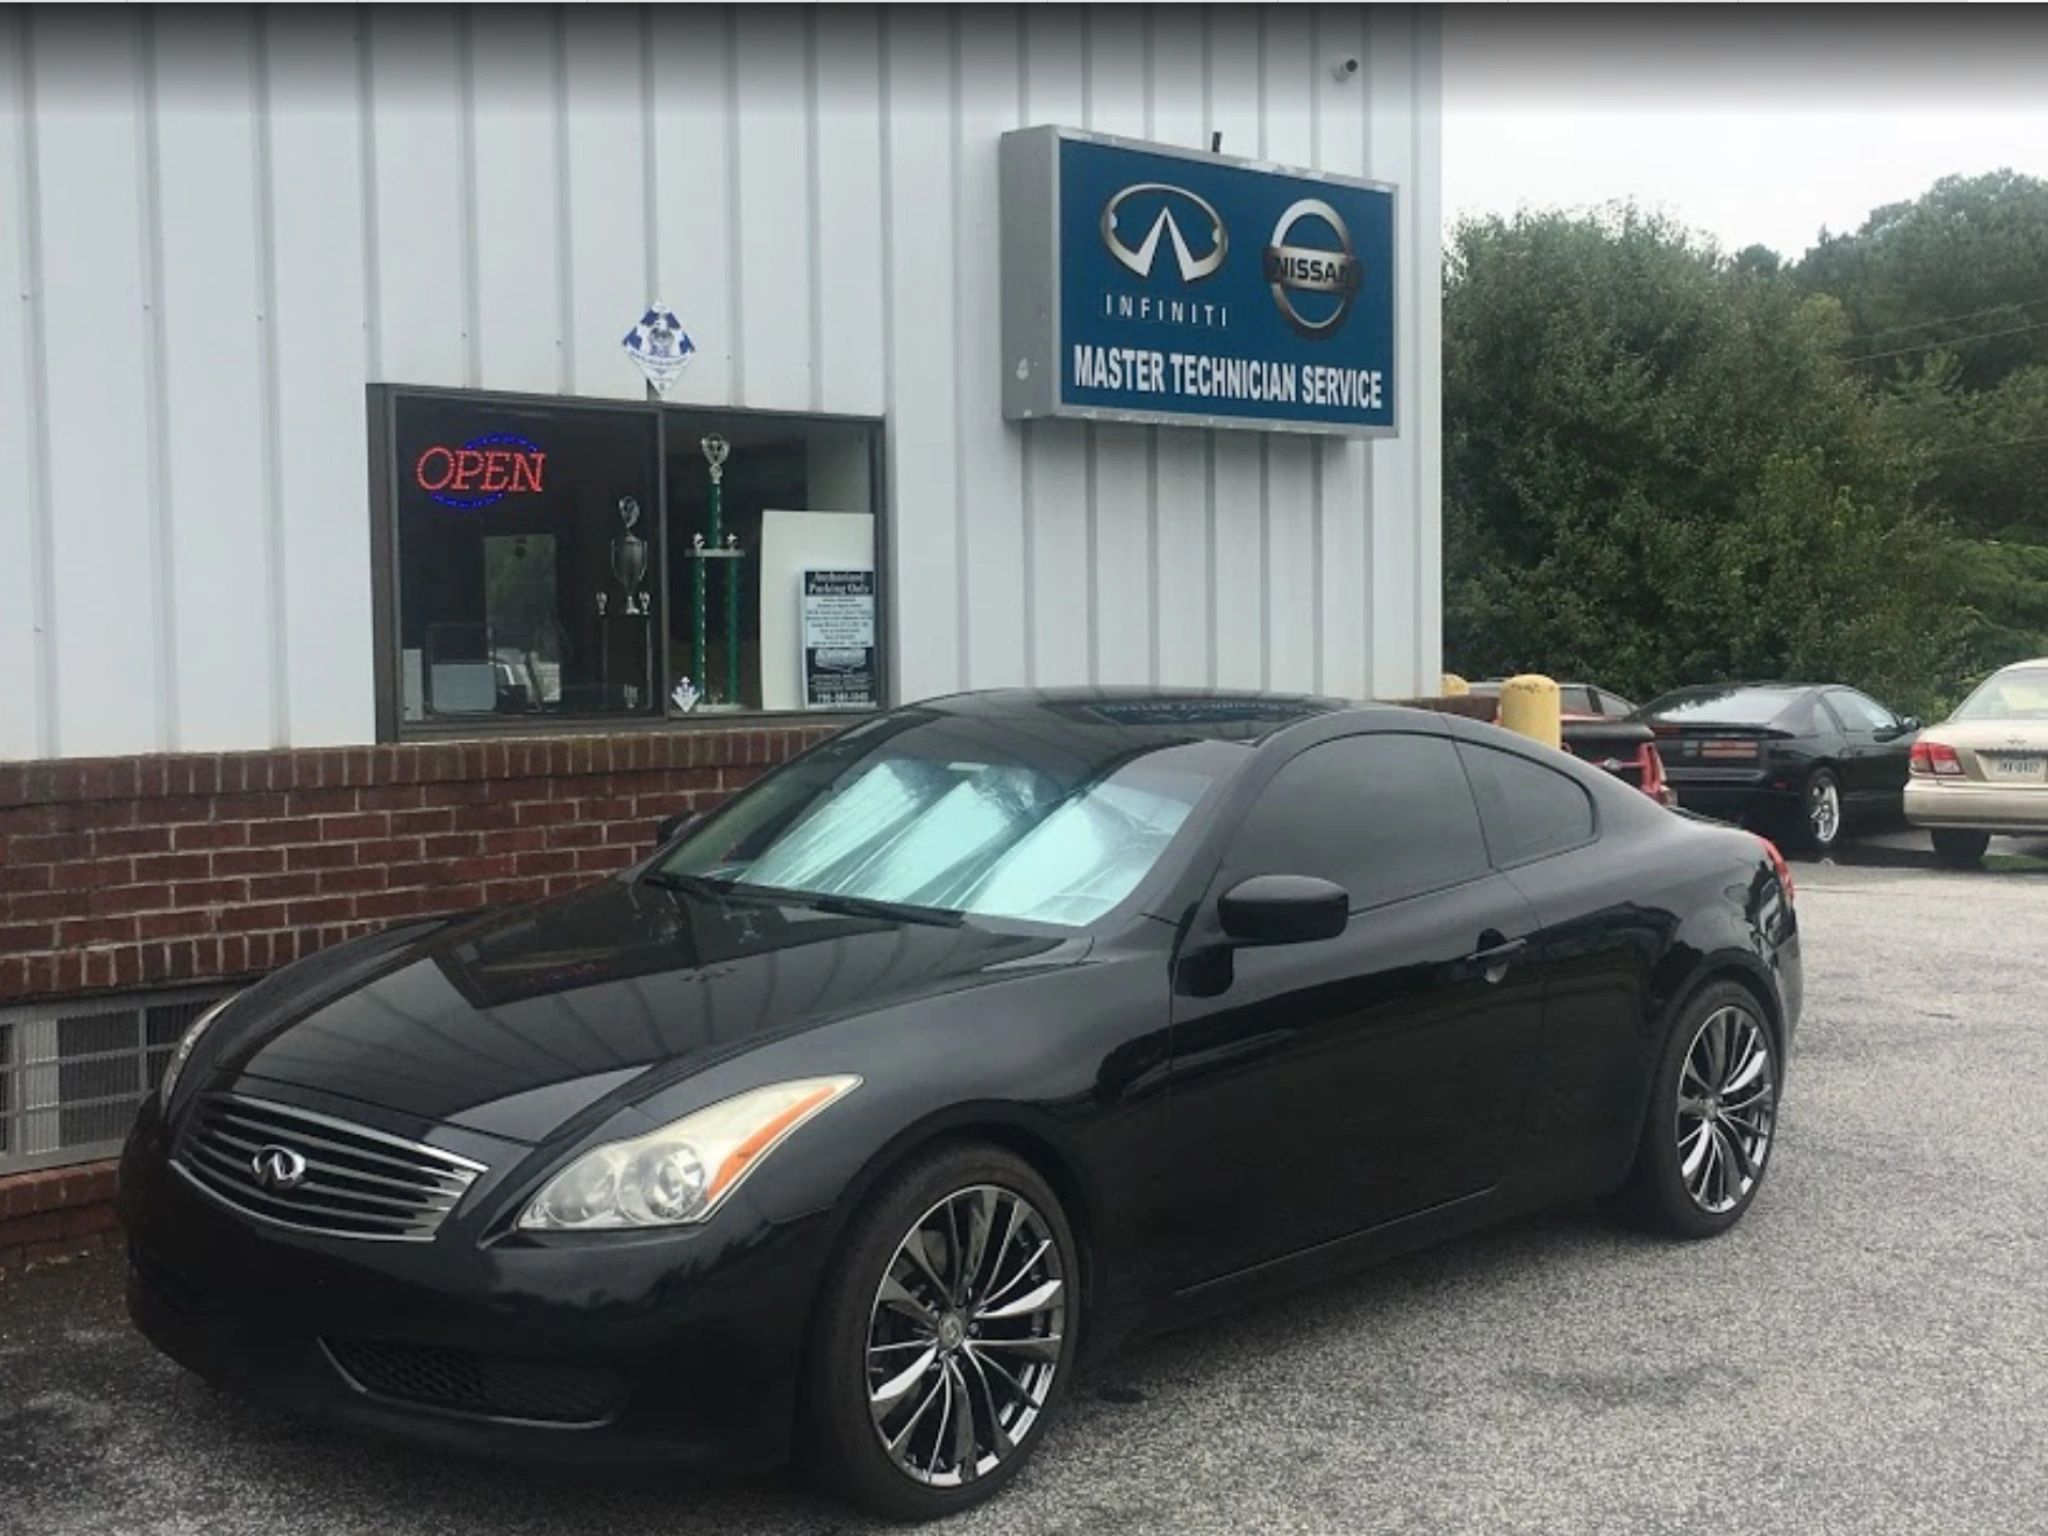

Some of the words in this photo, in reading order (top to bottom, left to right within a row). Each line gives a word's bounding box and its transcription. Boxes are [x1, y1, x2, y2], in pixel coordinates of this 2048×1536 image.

[1275, 257, 1351, 283] NISSAN
[1106, 294, 1227, 327] INFINITI
[1074, 345, 1165, 393] MASTER
[1170, 353, 1296, 402] TECHNICIAN
[1302, 365, 1382, 409] SERVICE
[418, 446, 546, 492] OPEN
